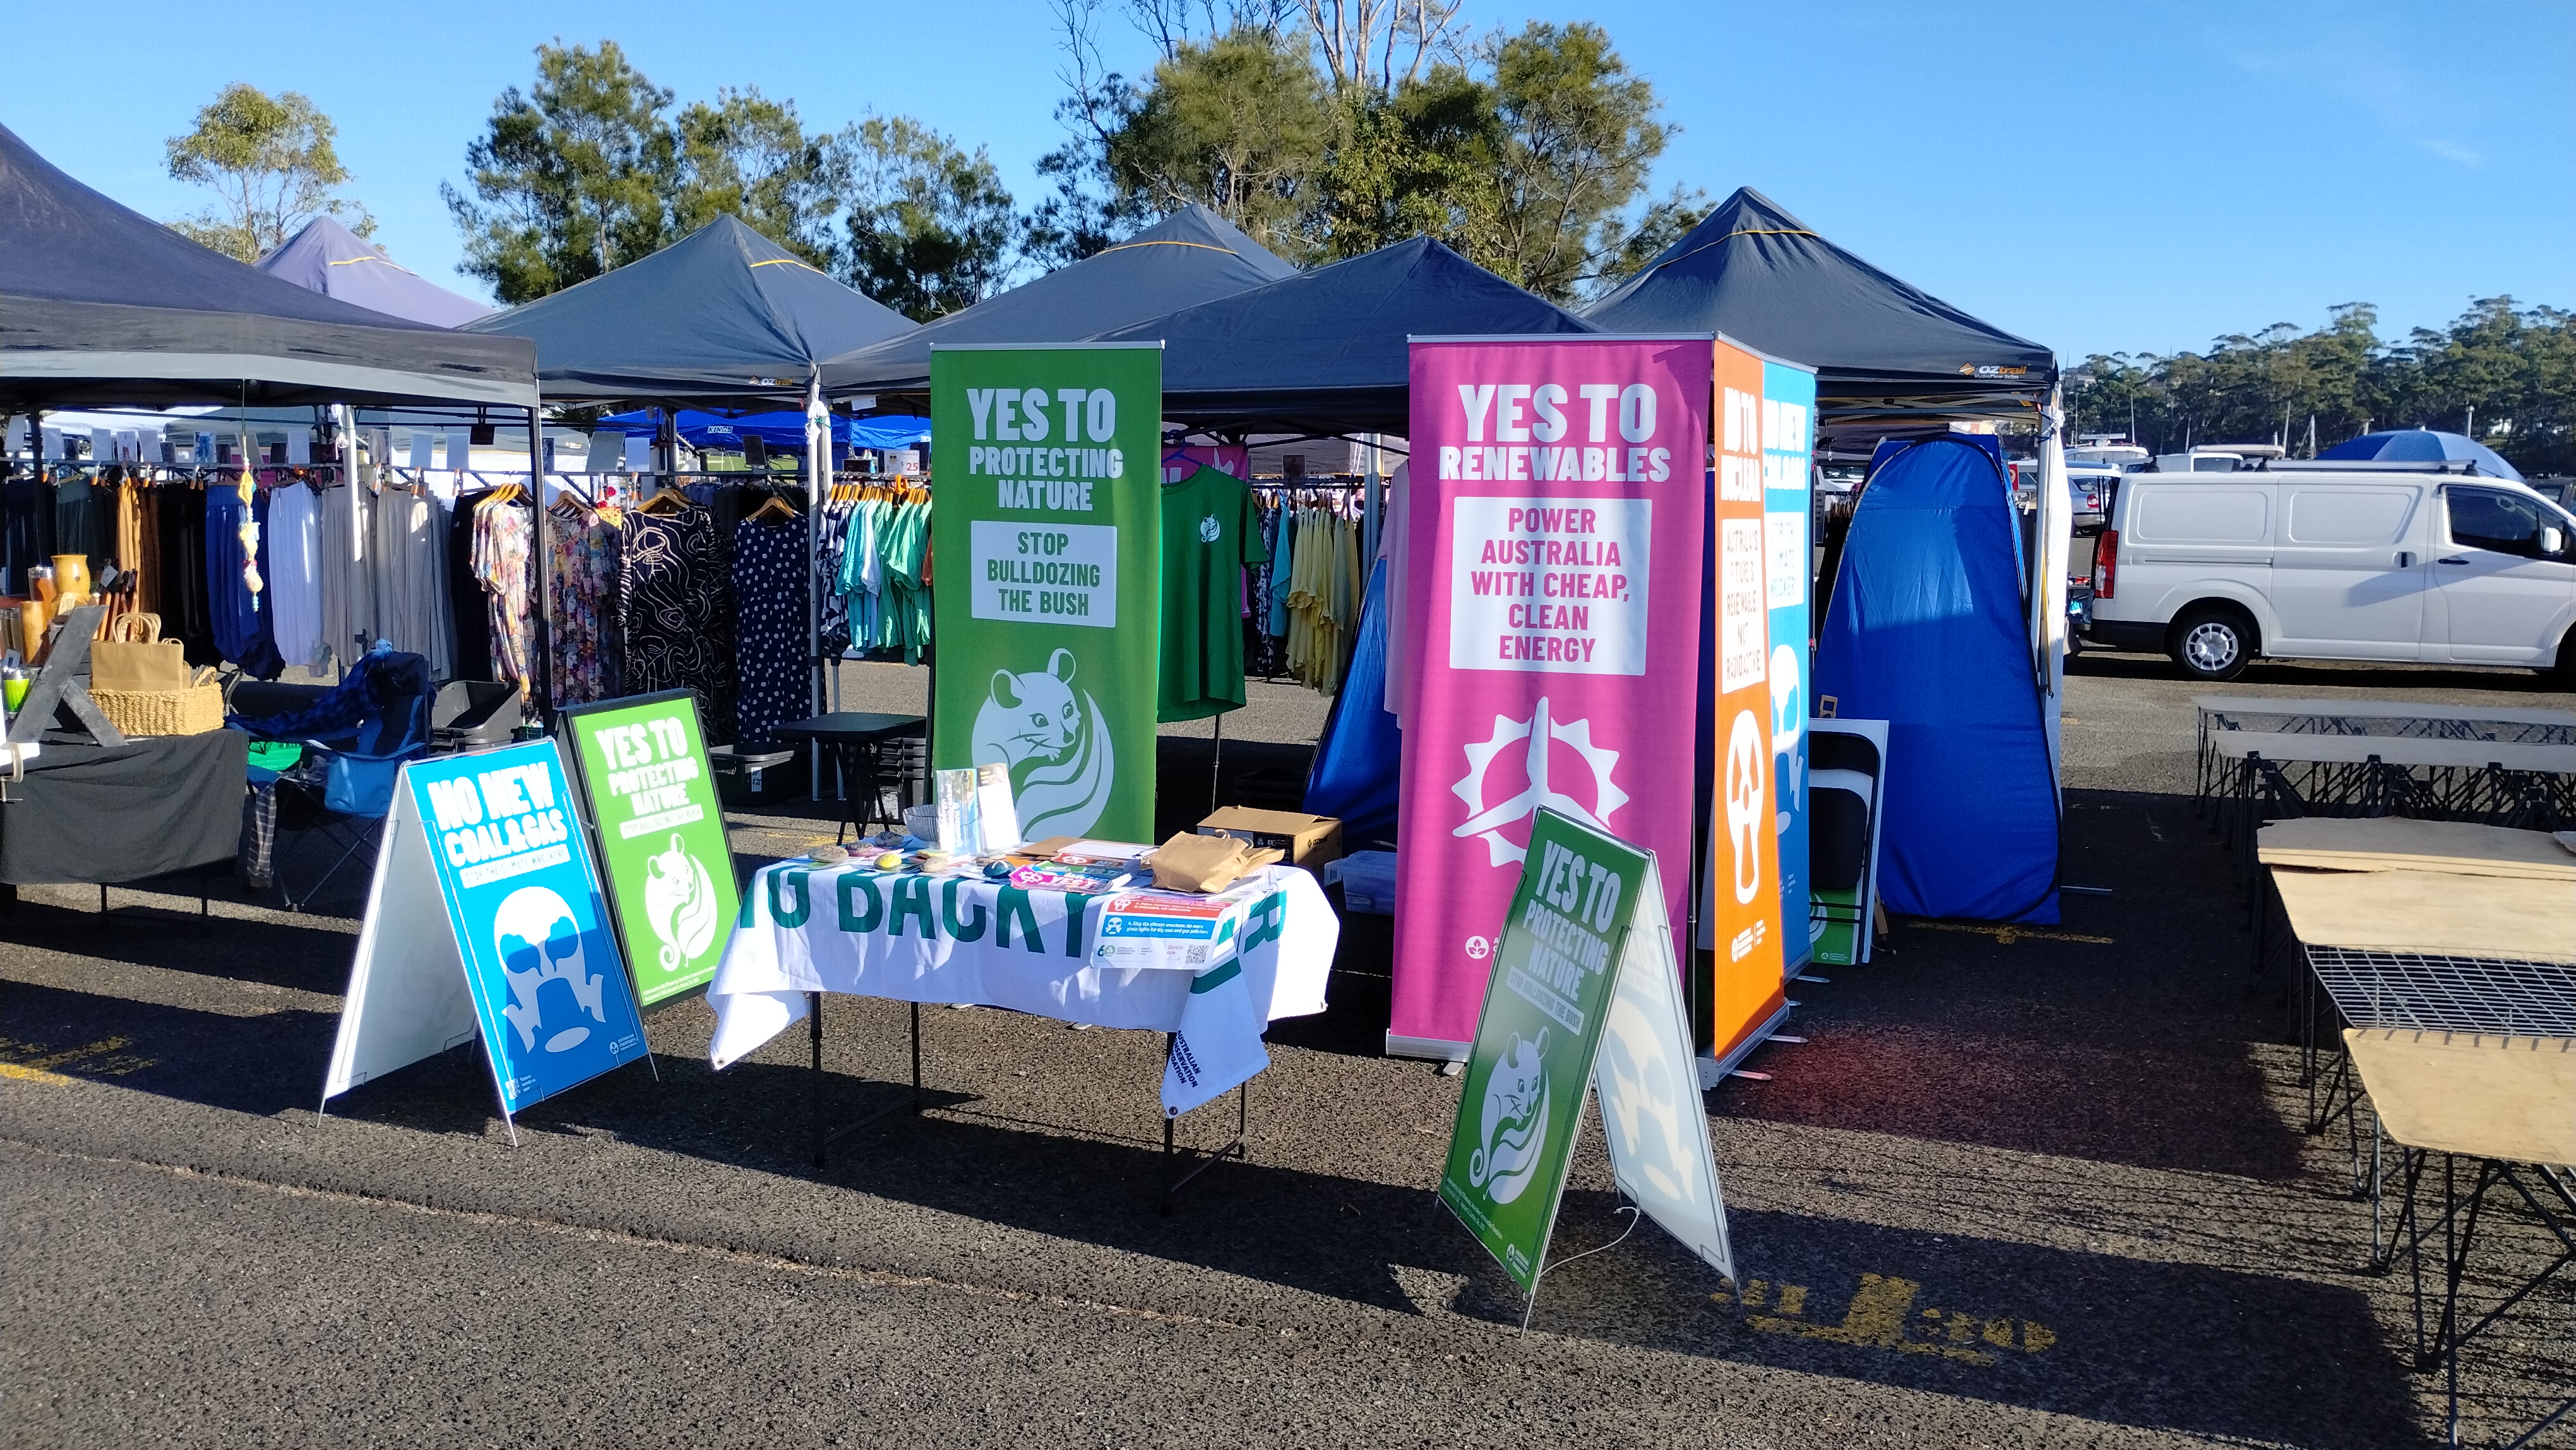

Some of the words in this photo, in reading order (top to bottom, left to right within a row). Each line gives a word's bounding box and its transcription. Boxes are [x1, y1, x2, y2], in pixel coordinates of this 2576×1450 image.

[1978, 365, 2027, 374] OZtrail
[967, 388, 1049, 441] YES
[1058, 388, 1116, 443] TO
[1458, 383, 1568, 443] YES
[1579, 383, 1657, 443] TO
[1741, 392, 1757, 455] TO
[906, 462, 919, 471] 25
[969, 446, 1123, 479] PROTECTING
[1439, 446, 1671, 482] RENEWABLES
[998, 480, 1093, 512] NATURE
[1508, 508, 1596, 534] POWER
[1018, 531, 1068, 555] STOP
[1481, 539, 1621, 567] AUSTRALIA
[987, 558, 1100, 588] BULLDOZING
[1470, 570, 1534, 597] WITH
[1543, 572, 1630, 603] CHEAP,
[998, 588, 1032, 613] THE
[1039, 590, 1089, 616] BUSH
[1508, 603, 1589, 631] CLEAN
[1499, 635, 1596, 662] ENERGY
[595, 721, 654, 772] YES
[648, 716, 689, 758] TO
[608, 757, 700, 798] PROTECTING
[426, 777, 485, 832] NO
[476, 761, 556, 820] NEW
[629, 782, 690, 817] NATURE
[443, 808, 569, 868] COAL&GAS
[1535, 839, 1586, 914] YES
[1583, 863, 1621, 933] TO
[1522, 899, 1609, 976] PROTECTING
[1527, 939, 1585, 1002] NATURE
[1510, 971, 1524, 988] STOP
[1523, 980, 1555, 1012] BULLDOZING
[1554, 1001, 1567, 1020] THE
[1565, 1009, 1582, 1031] BUSH
[1178, 1029, 1202, 1075] AUSTRALIAN
